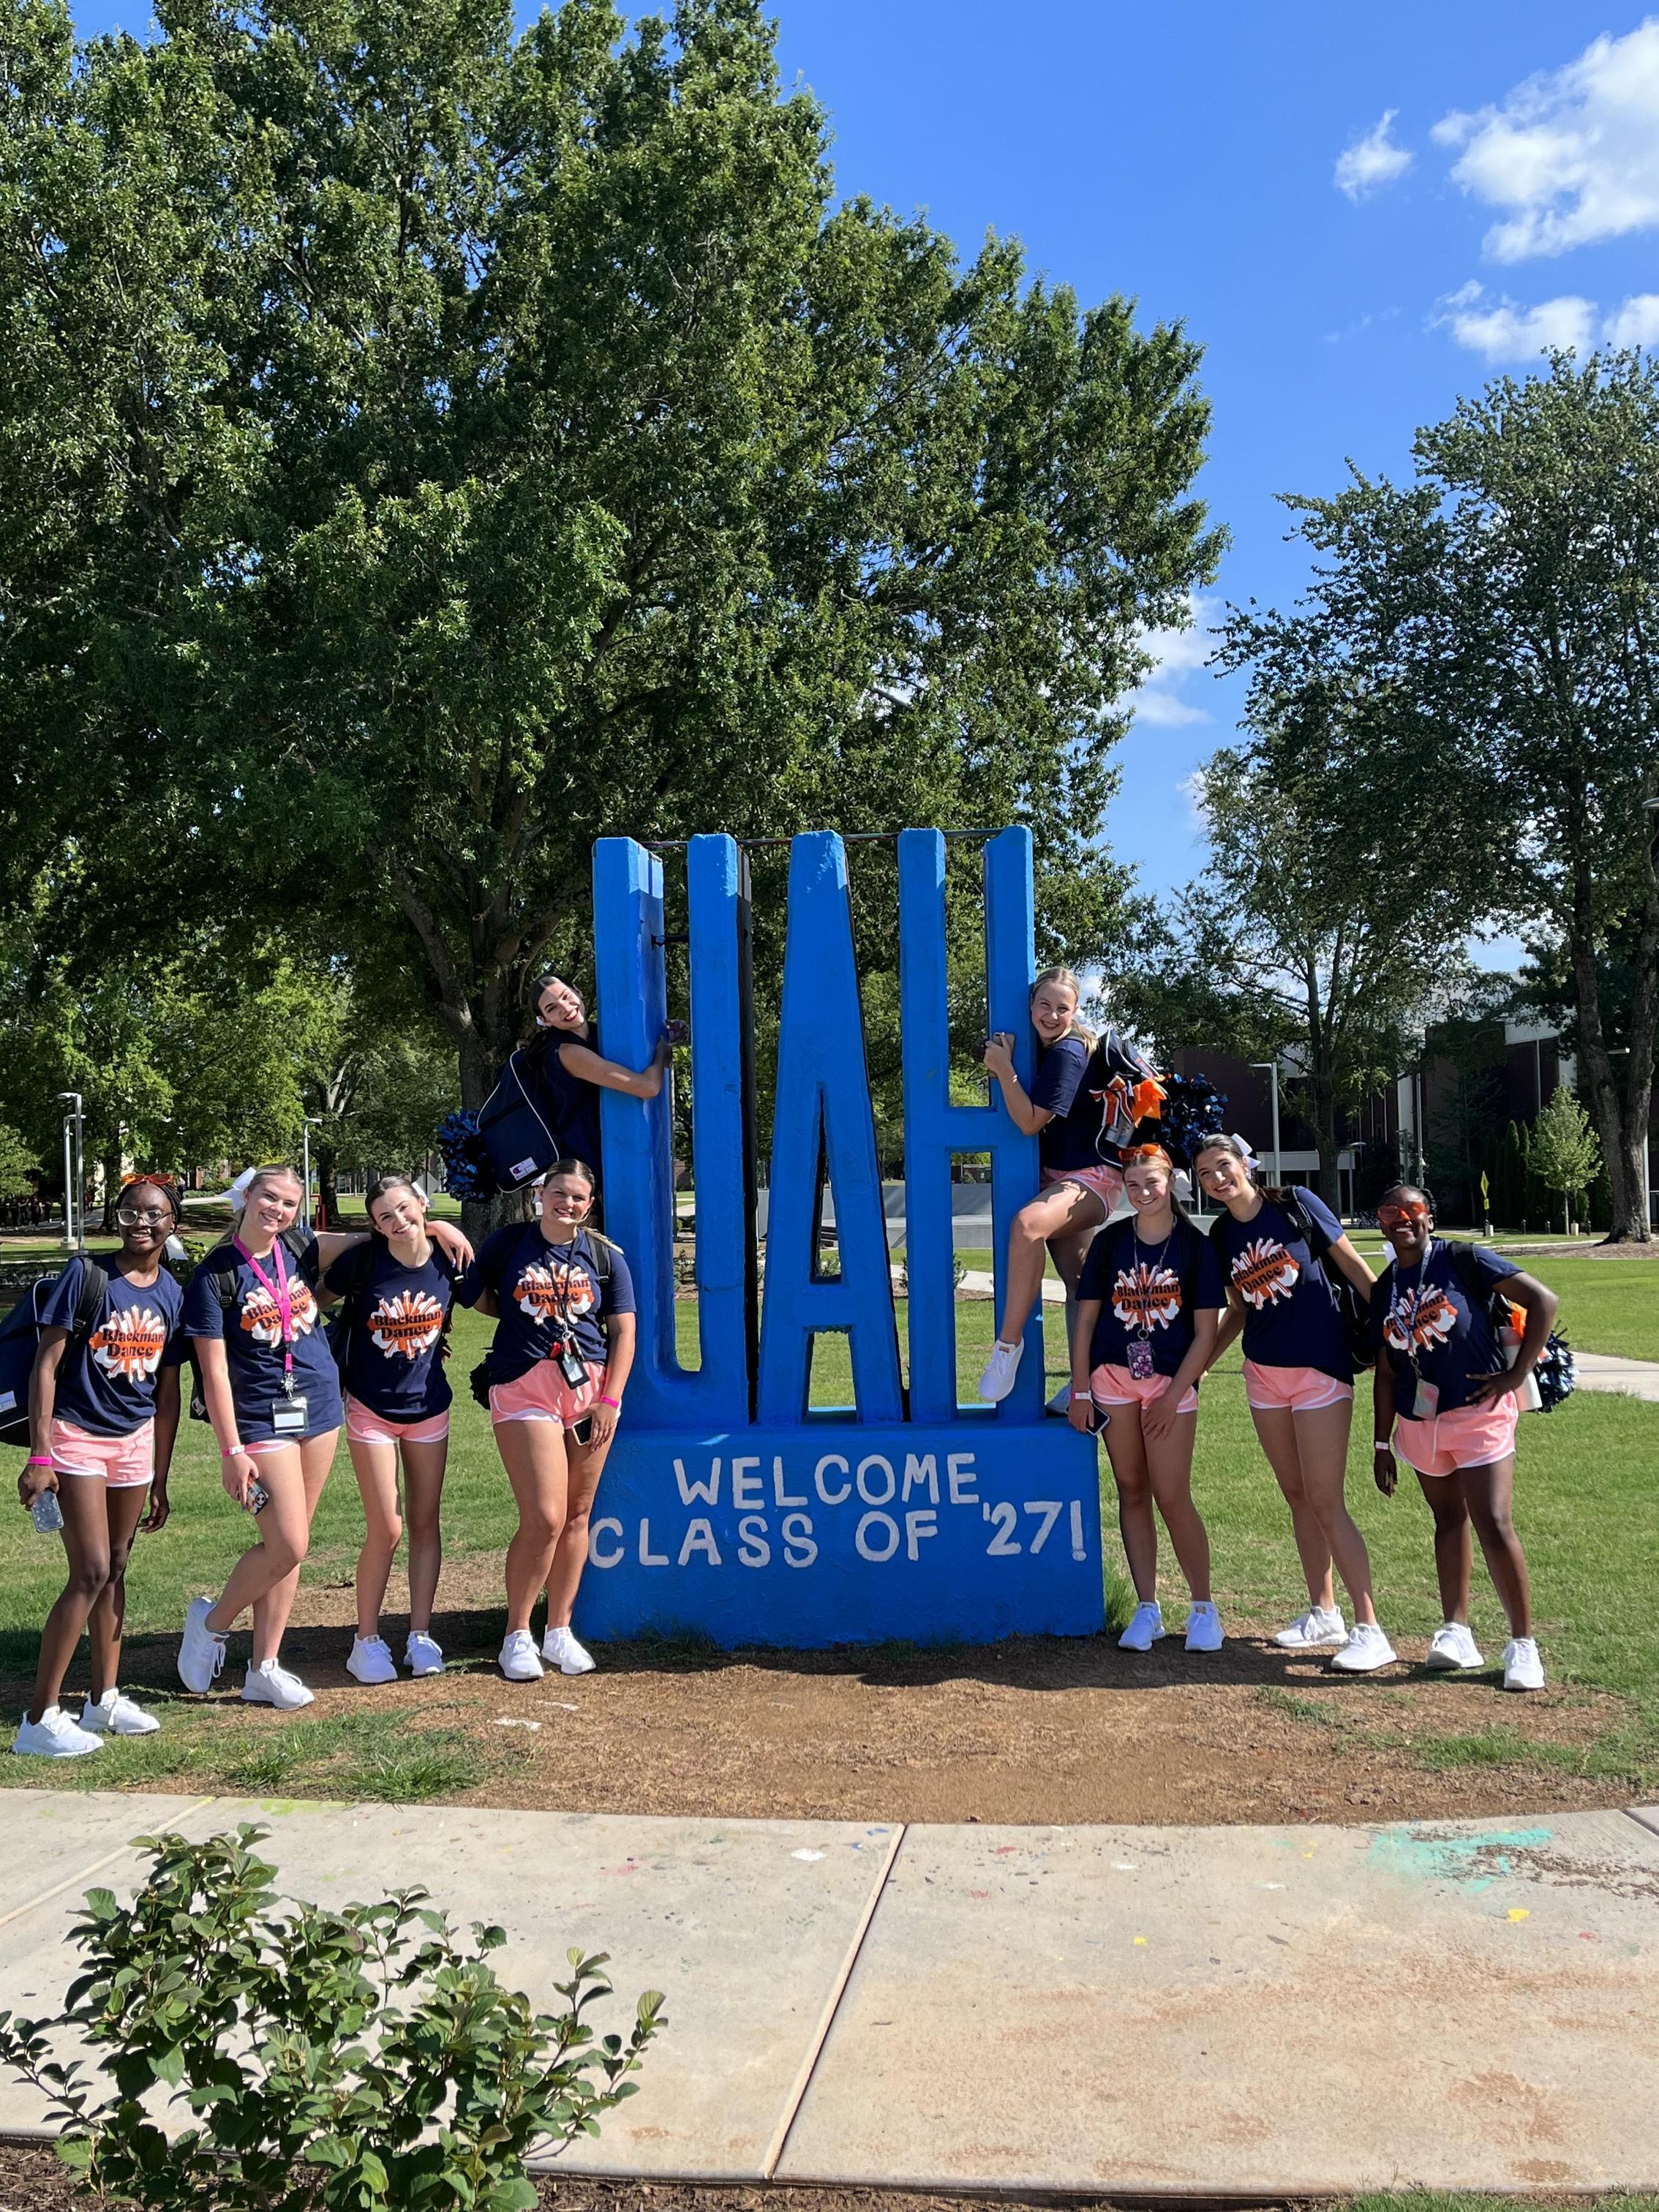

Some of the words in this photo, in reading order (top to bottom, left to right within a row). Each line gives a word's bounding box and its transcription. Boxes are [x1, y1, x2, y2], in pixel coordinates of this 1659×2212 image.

[593, 824, 1045, 1423] UAH
[1233, 1249, 1287, 1284] Blackman
[521, 1279, 590, 1292] Blacman
[1241, 1266, 1283, 1294] Dance
[1117, 1283, 1180, 1298] Blackman
[1122, 1297, 1168, 1311] Dance
[257, 1301, 307, 1329] Dace
[375, 1312, 440, 1326] Blackman
[102, 1328, 164, 1343] Blackman
[381, 1325, 429, 1339] Dance
[107, 1343, 154, 1358] Dance
[673, 1452, 980, 1511] WELCOME
[589, 1512, 819, 1569] CLASS
[854, 1509, 939, 1562] OF
